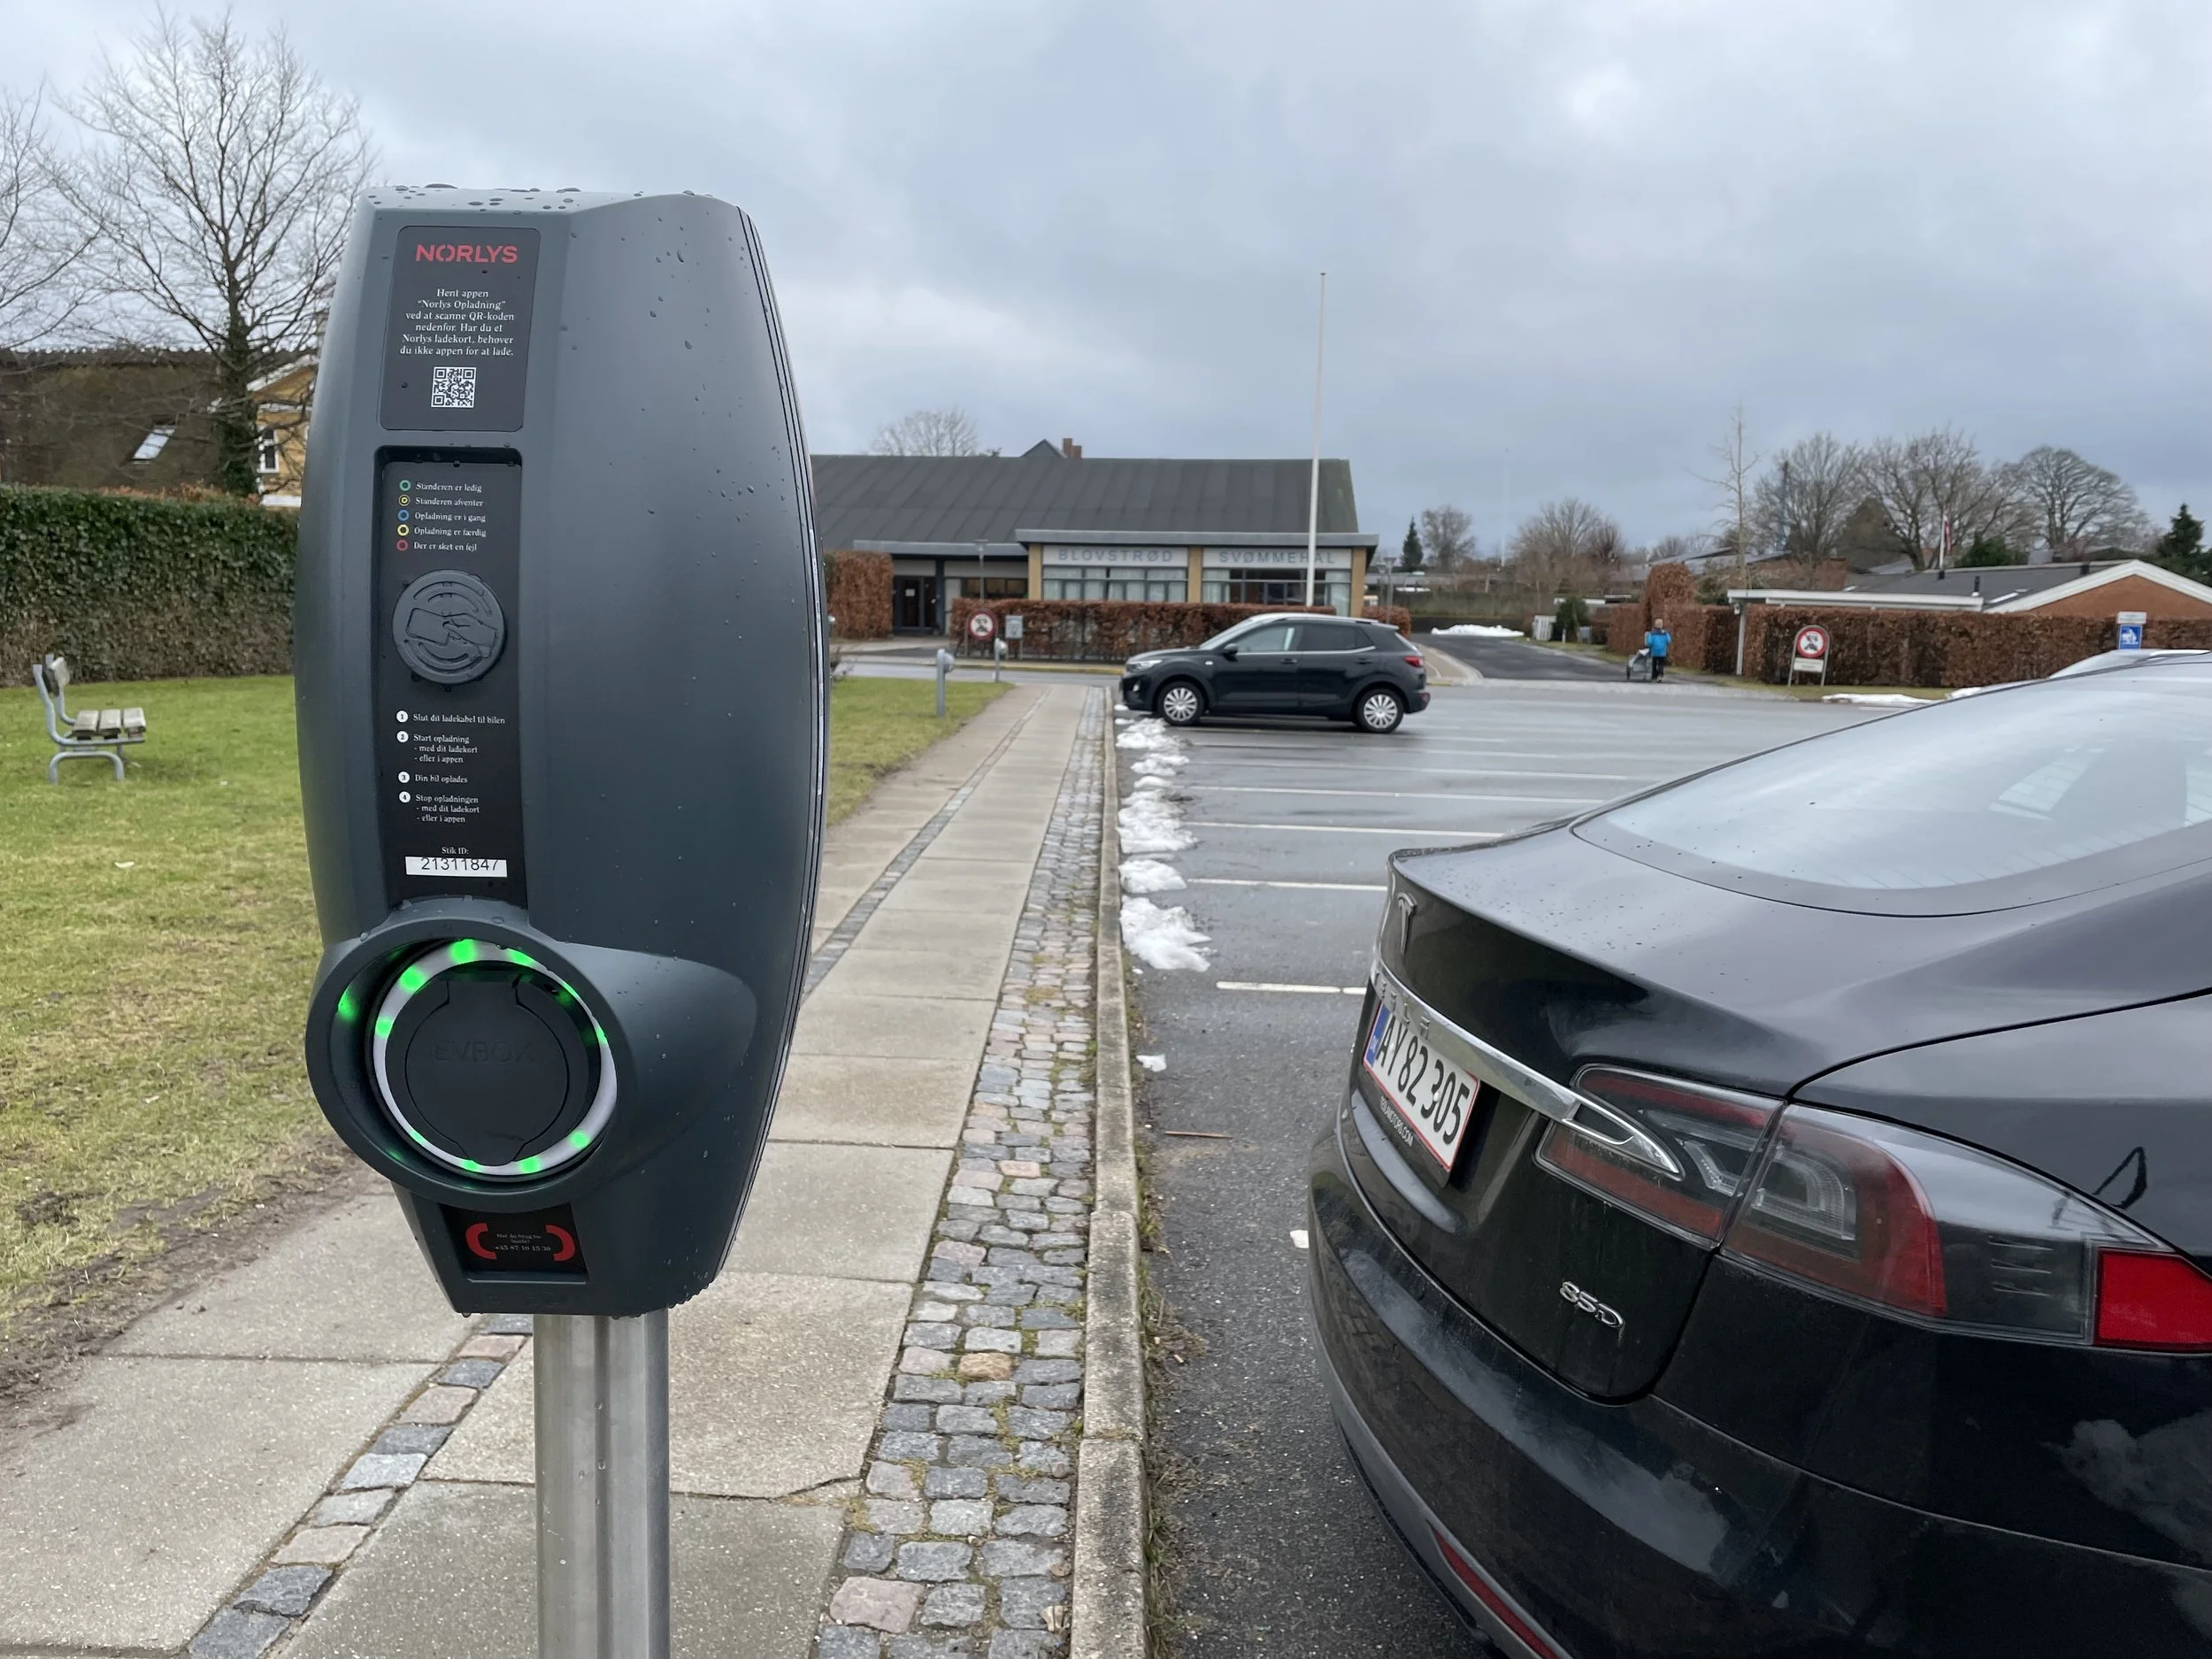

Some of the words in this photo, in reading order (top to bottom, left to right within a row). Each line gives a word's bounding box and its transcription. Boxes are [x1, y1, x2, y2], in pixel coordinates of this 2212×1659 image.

[415, 244, 518, 264] NORLYS
[436, 288, 459, 297] Hent
[461, 290, 488, 299] appen
[405, 311, 422, 319] ved
[468, 311, 514, 321] QR-koden
[415, 322, 457, 332] nedenfor.
[460, 323, 478, 332] Har
[480, 323, 492, 333] du
[494, 324, 503, 333] et
[403, 334, 433, 344] Norlys
[477, 334, 514, 344] behøver
[400, 345, 412, 355] du
[414, 345, 434, 355] ikke
[435, 348, 464, 357] appen
[465, 346, 480, 356] for
[415, 482, 453, 491] Standeren
[464, 483, 482, 493] ledig
[415, 497, 452, 506] Standeren
[454, 498, 484, 507] afventer
[414, 511, 452, 521] Opladning
[414, 526, 452, 536] Opladning
[463, 528, 487, 537] færdig
[465, 542, 477, 553] fejl
[1058, 548, 1173, 563] BLOVSTRØD
[1219, 550, 1335, 565] SVØMMEHAL
[442, 714, 476, 723] ladekabel
[477, 715, 486, 724] til
[413, 733, 432, 742] Start
[433, 734, 470, 744] opladning
[436, 744, 447, 753] dit
[448, 745, 478, 754] ladekort
[419, 754, 435, 763] eller
[441, 774, 468, 784] oplades
[415, 794, 433, 803] Stop
[434, 795, 479, 804] opladningen
[450, 804, 480, 813] ladekort
[442, 846, 457, 855] Stik
[420, 857, 499, 872] 21311847
[1398, 1035, 1429, 1107] 82
[1420, 1059, 1471, 1145] 305
